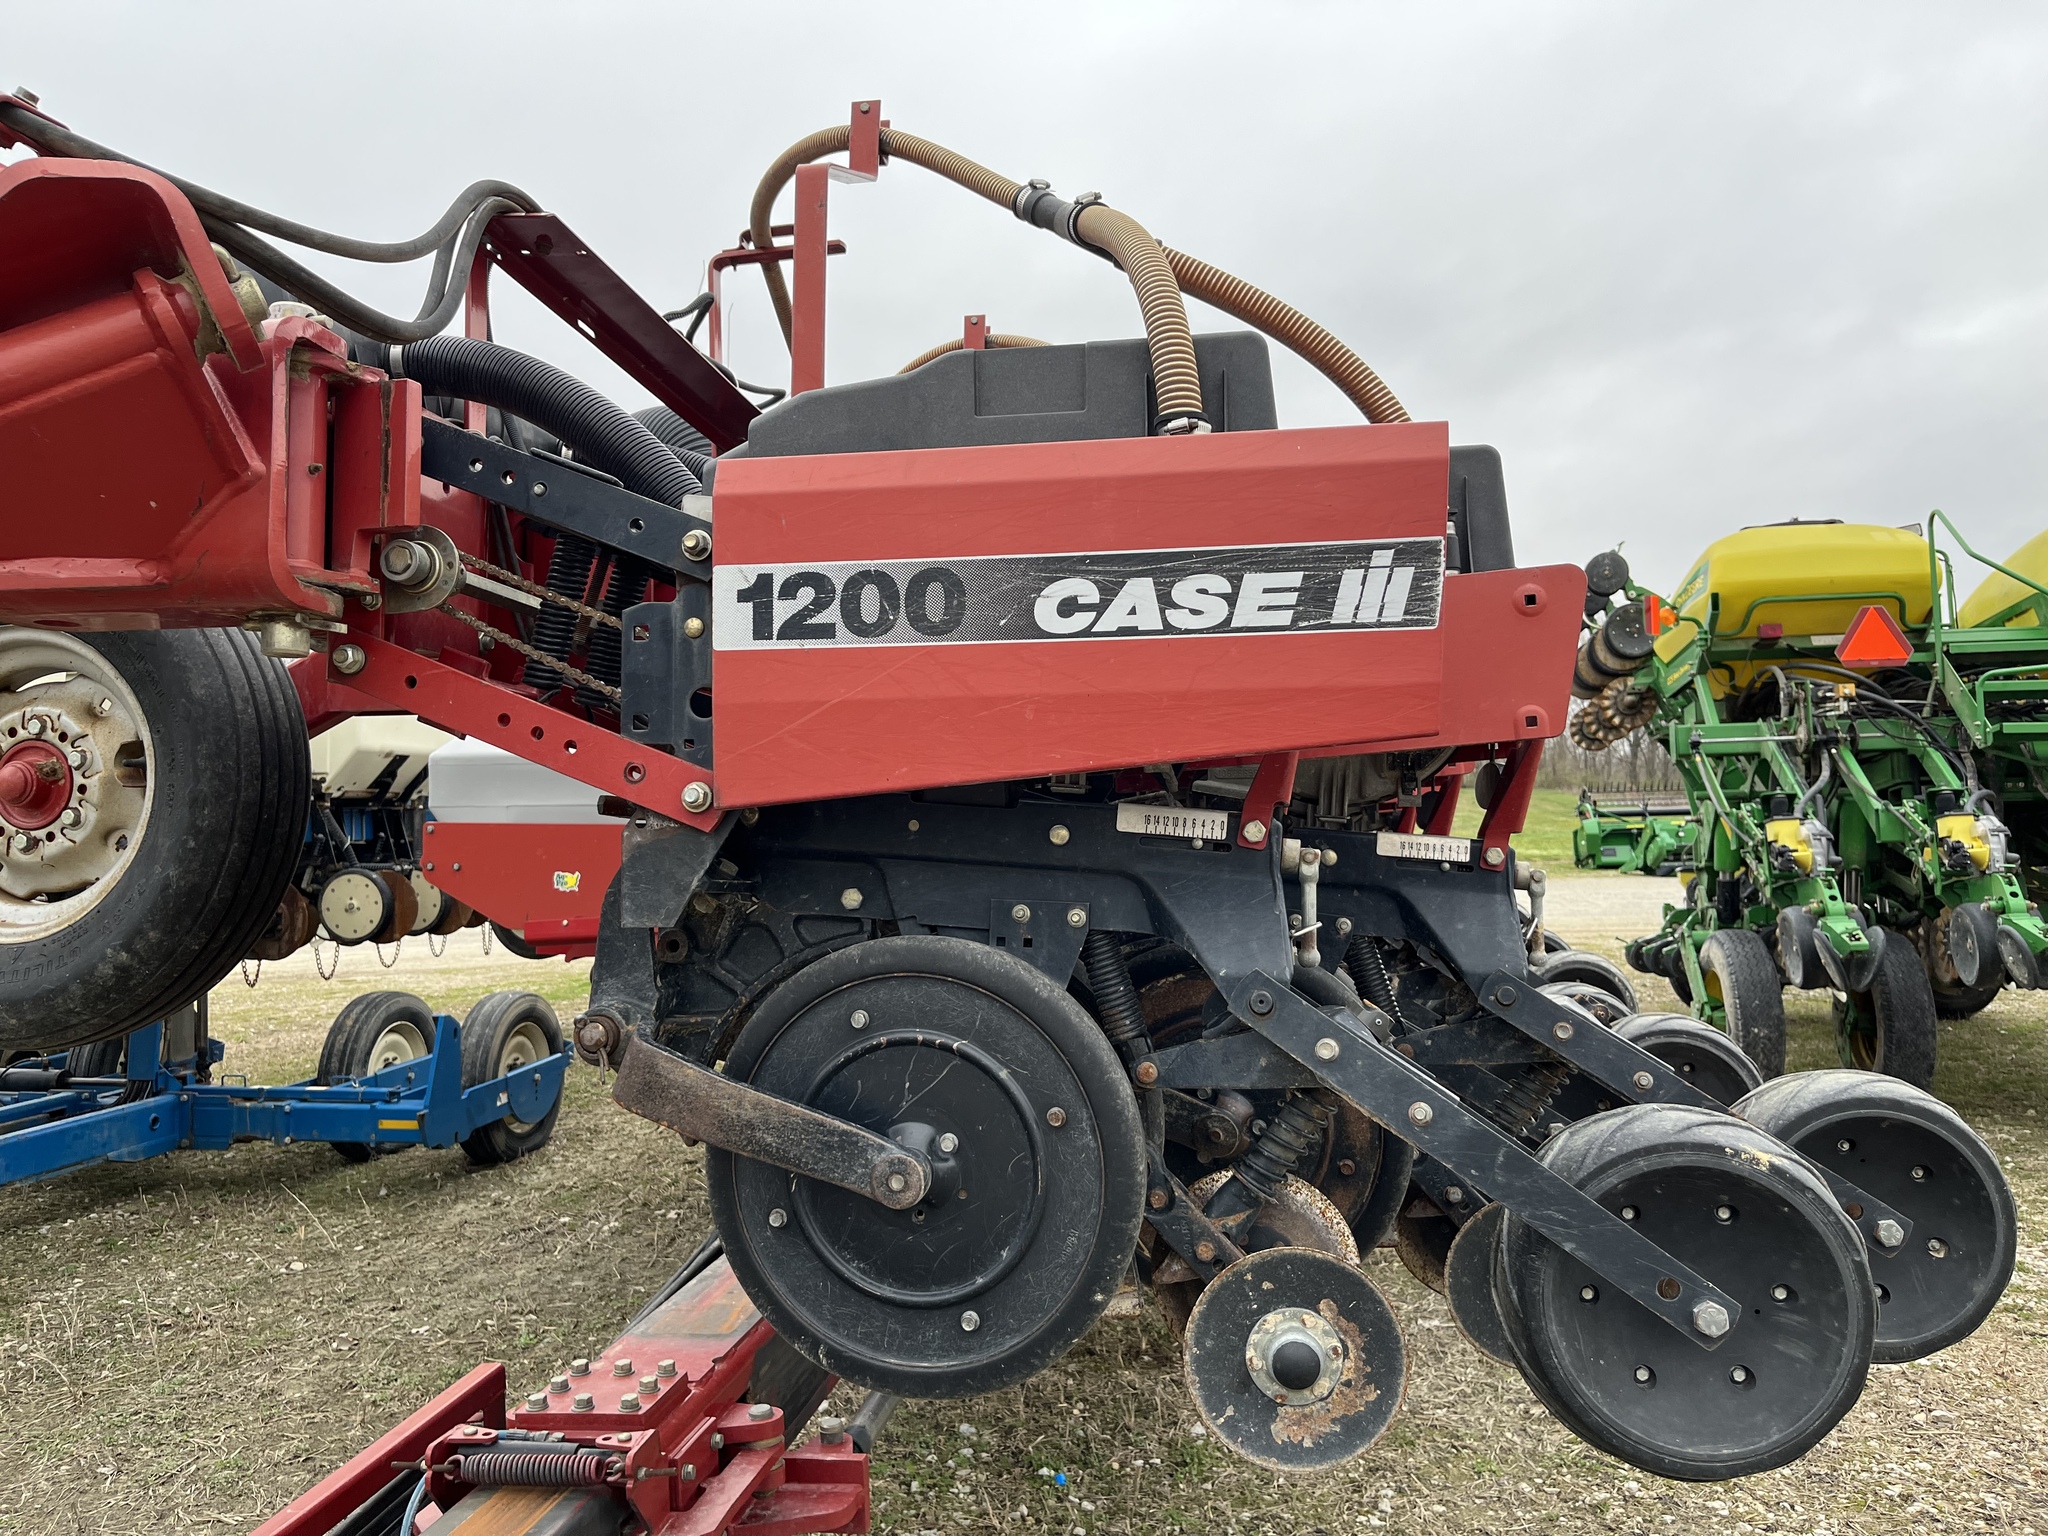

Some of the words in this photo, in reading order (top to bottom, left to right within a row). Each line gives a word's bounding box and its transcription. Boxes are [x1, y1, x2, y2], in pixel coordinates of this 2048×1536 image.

[736, 567, 965, 641] 1200
[1033, 570, 1304, 633] CASE
[1144, 815, 1151, 825] 16
[1153, 815, 1160, 826] 14
[1163, 816, 1170, 827] 12
[1172, 816, 1179, 828] 10
[1400, 841, 1406, 850] 16
[1407, 842, 1414, 850] 14
[1415, 842, 1422, 851] 12
[1423, 843, 1430, 852] 10
